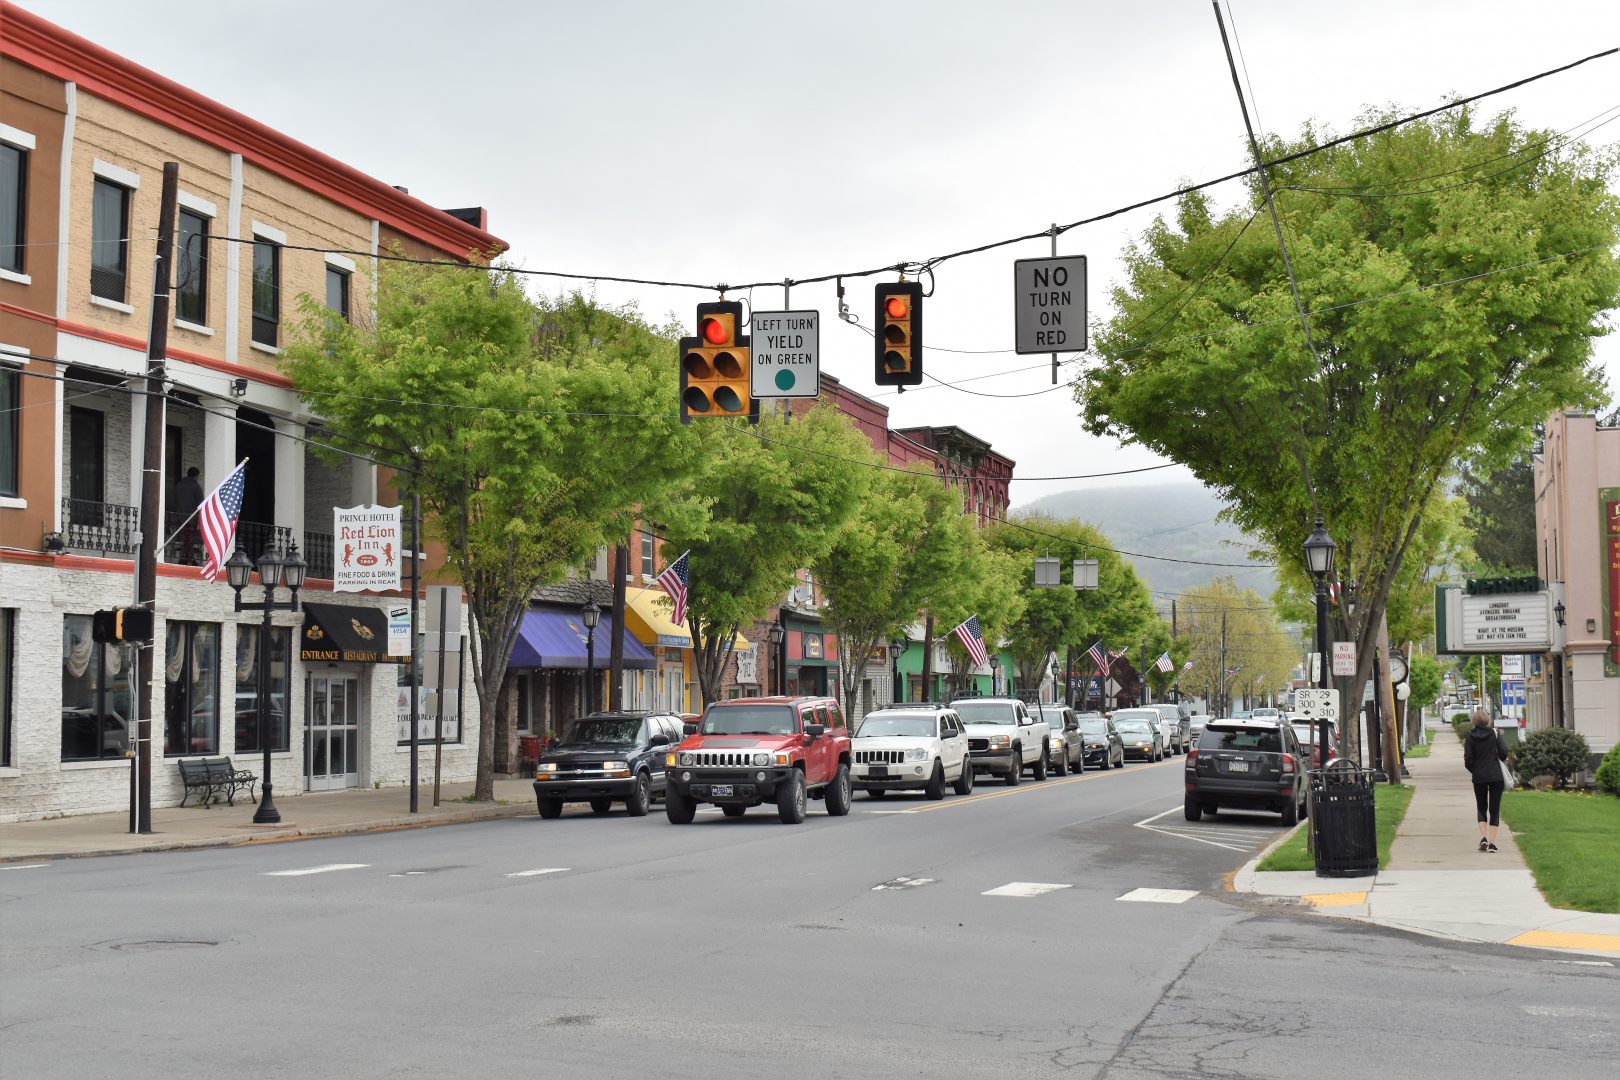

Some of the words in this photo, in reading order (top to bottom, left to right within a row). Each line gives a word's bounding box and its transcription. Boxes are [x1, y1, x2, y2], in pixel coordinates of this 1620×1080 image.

[1033, 266, 1068, 288] NO
[1029, 291, 1071, 307] TURN
[757, 319, 781, 331] LEFT
[786, 318, 813, 330] TURN
[1040, 311, 1061, 326] ON
[767, 335, 803, 349] YIELD
[1036, 330, 1066, 345] RED
[758, 354, 772, 365] ON
[777, 353, 812, 365] GREEN
[340, 514, 368, 522] PRINCE
[340, 526, 364, 540] Red
[367, 525, 395, 538] Lion
[358, 540, 379, 550] Inn
[302, 650, 340, 660] ENTRANCE
[343, 652, 377, 661] RESTAURANT
[1299, 690, 1311, 699] SR
[1319, 690, 1331, 699] 29
[1298, 699, 1316, 709] 300
[1319, 708, 1335, 717] 310
